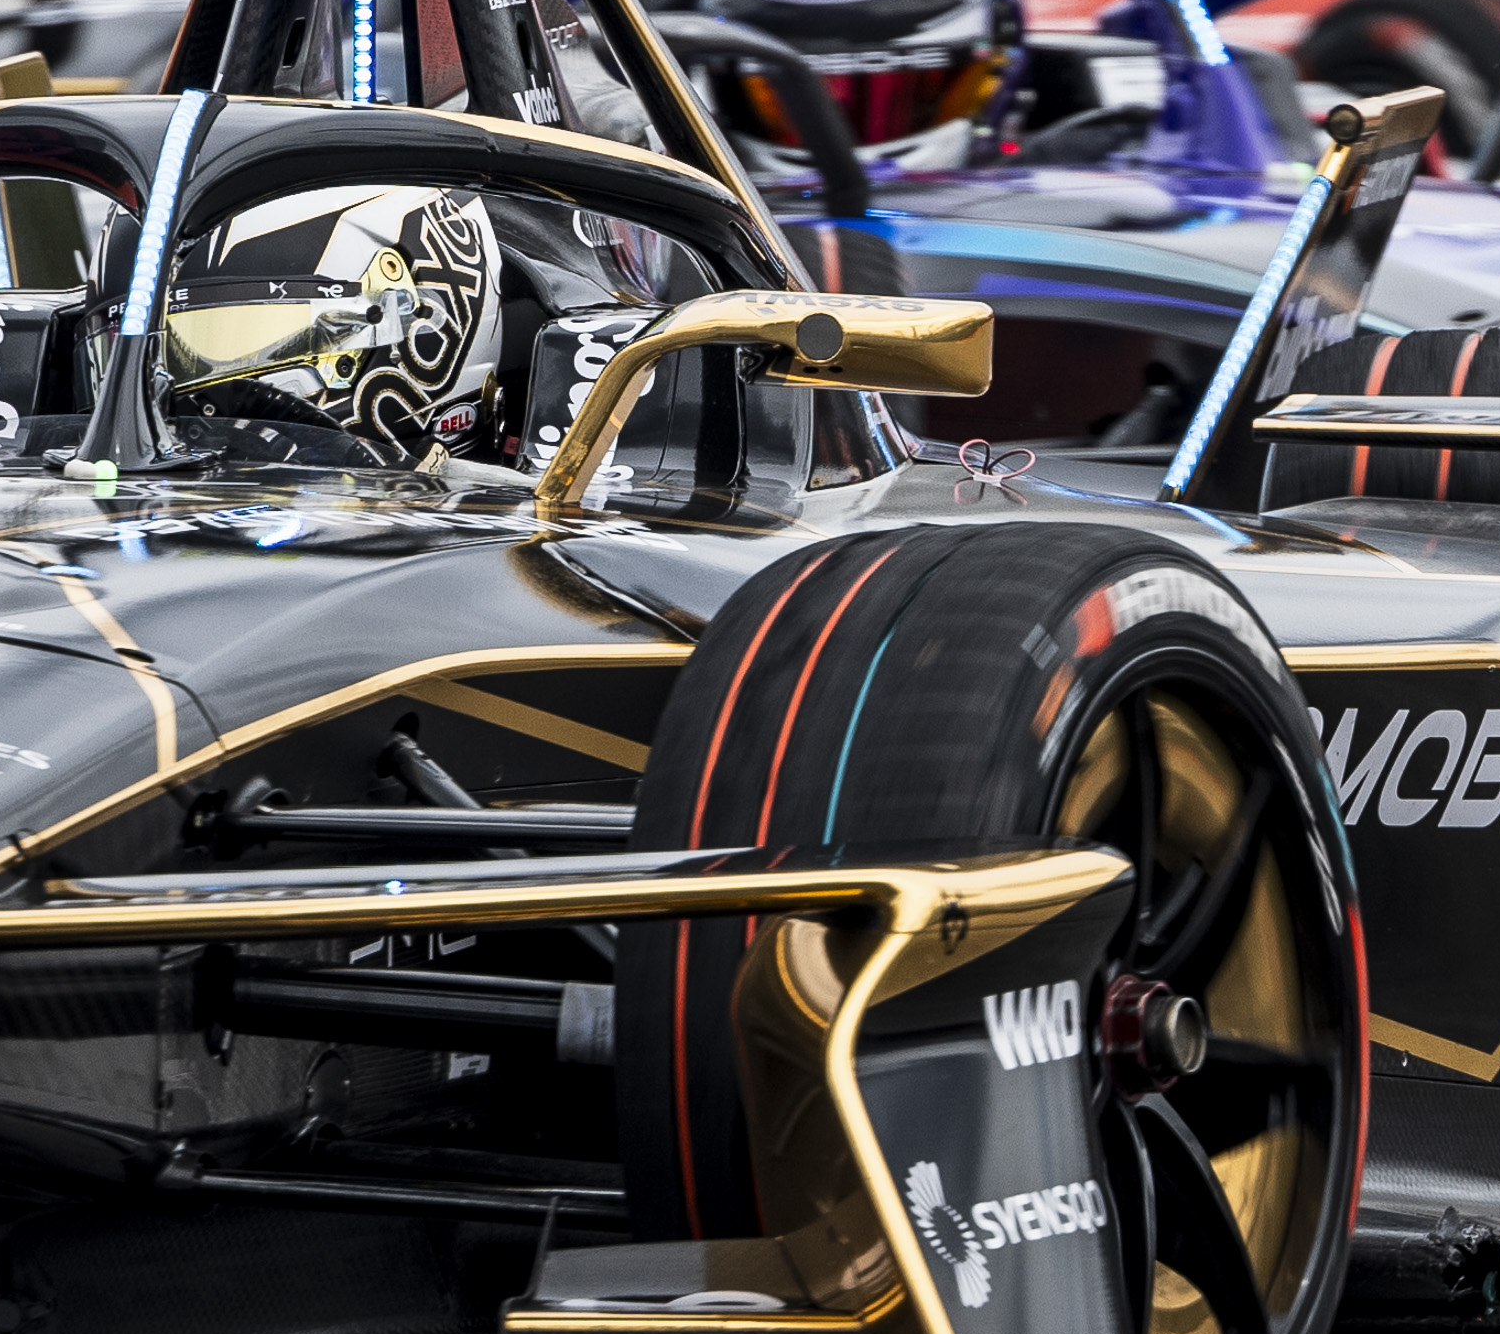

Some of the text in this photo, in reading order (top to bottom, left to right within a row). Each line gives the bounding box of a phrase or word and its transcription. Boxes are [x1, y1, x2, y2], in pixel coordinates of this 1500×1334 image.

[439, 411, 474, 436] BELL
[983, 979, 1082, 1071] WWD
[971, 1178, 1108, 1251] SYENSQO
